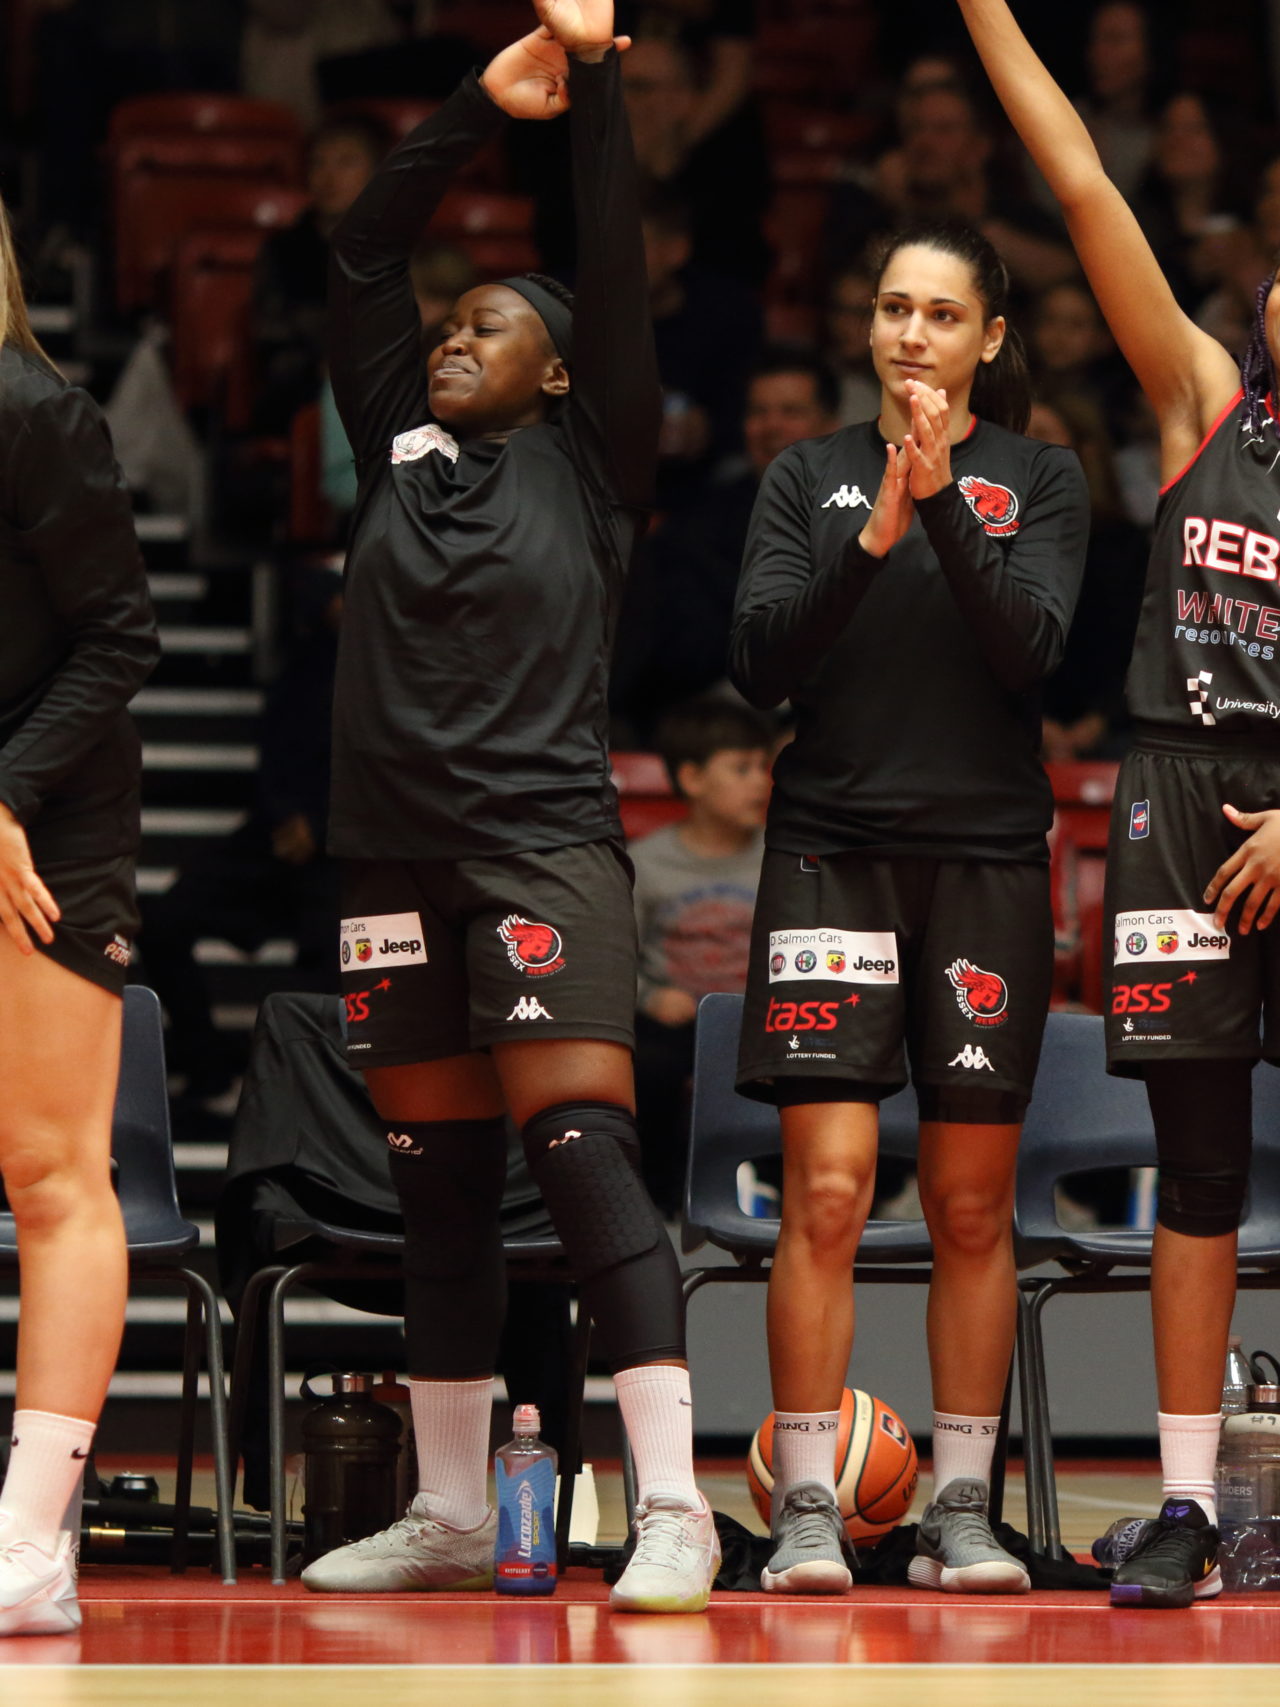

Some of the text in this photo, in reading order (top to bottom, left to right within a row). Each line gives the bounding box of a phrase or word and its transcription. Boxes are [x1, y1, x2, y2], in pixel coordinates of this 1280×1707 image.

[1148, 914, 1174, 925] Cars
[379, 938, 421, 955] Jeep
[778, 933, 816, 945] Salmon
[818, 932, 843, 944] Cars
[1187, 932, 1228, 949] Jeep
[507, 945, 526, 973] ESSEX
[853, 956, 895, 974] Jeep
[765, 996, 840, 1032] tass
[956, 990, 975, 1020] ESSEX
[518, 1490, 533, 1558] Lucozade
